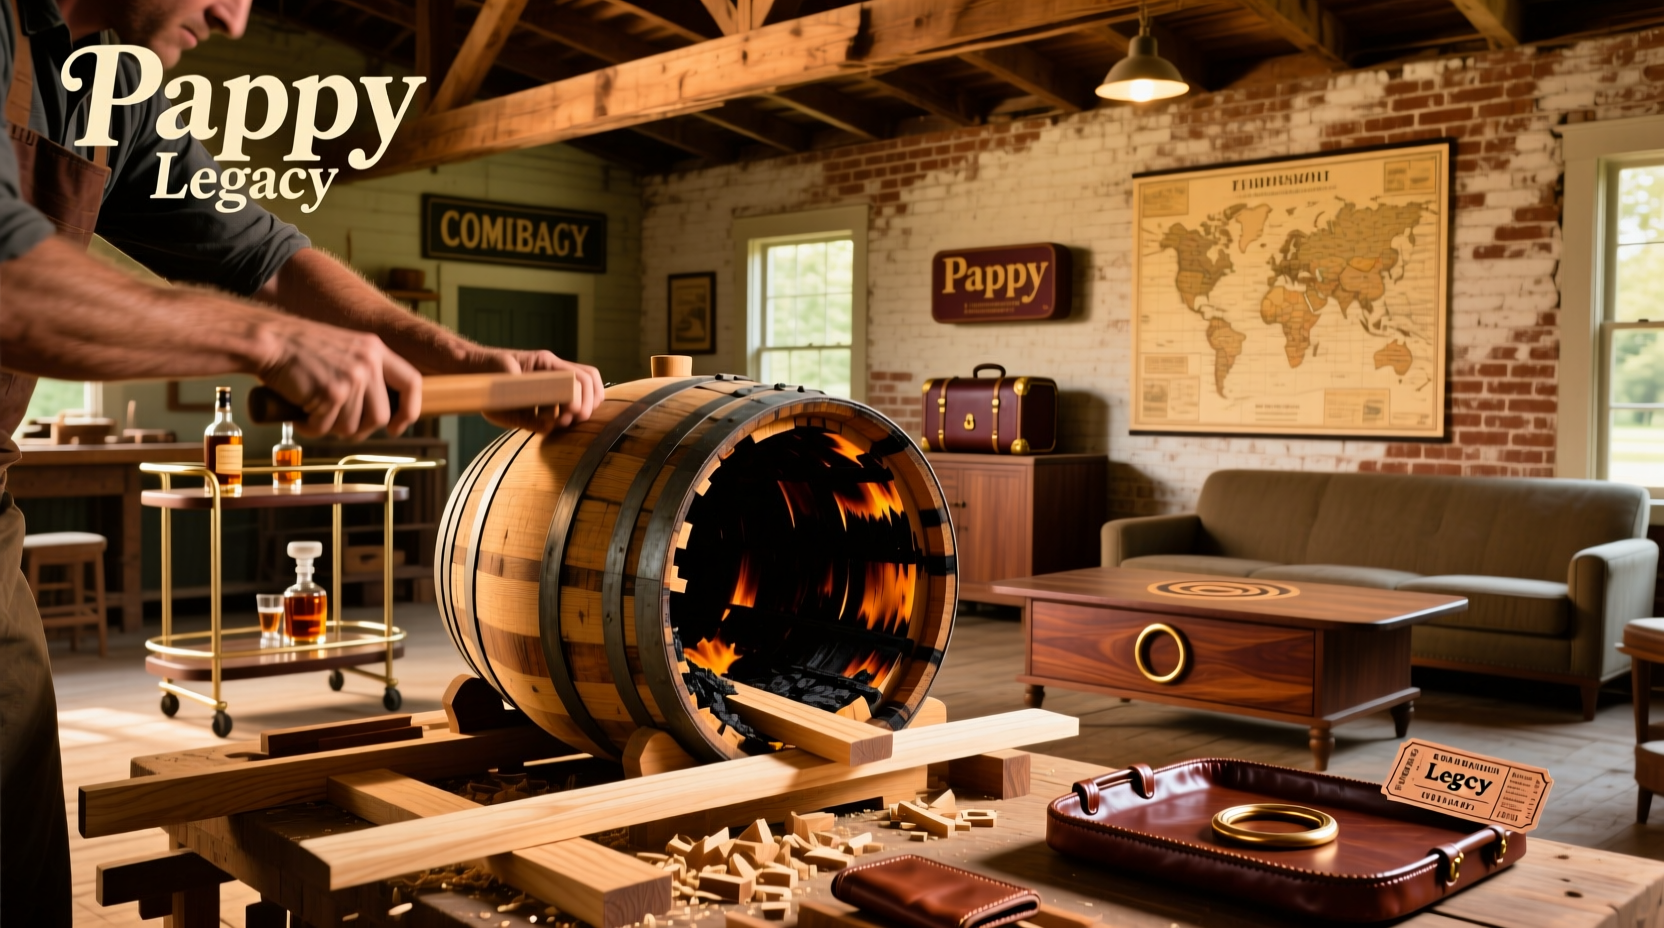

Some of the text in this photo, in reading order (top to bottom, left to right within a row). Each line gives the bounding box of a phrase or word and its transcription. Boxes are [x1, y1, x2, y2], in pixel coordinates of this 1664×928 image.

[440, 210, 589, 257] COMIBAGY
[942, 256, 1049, 304] Pappy
[1424, 762, 1494, 797] Legcy
